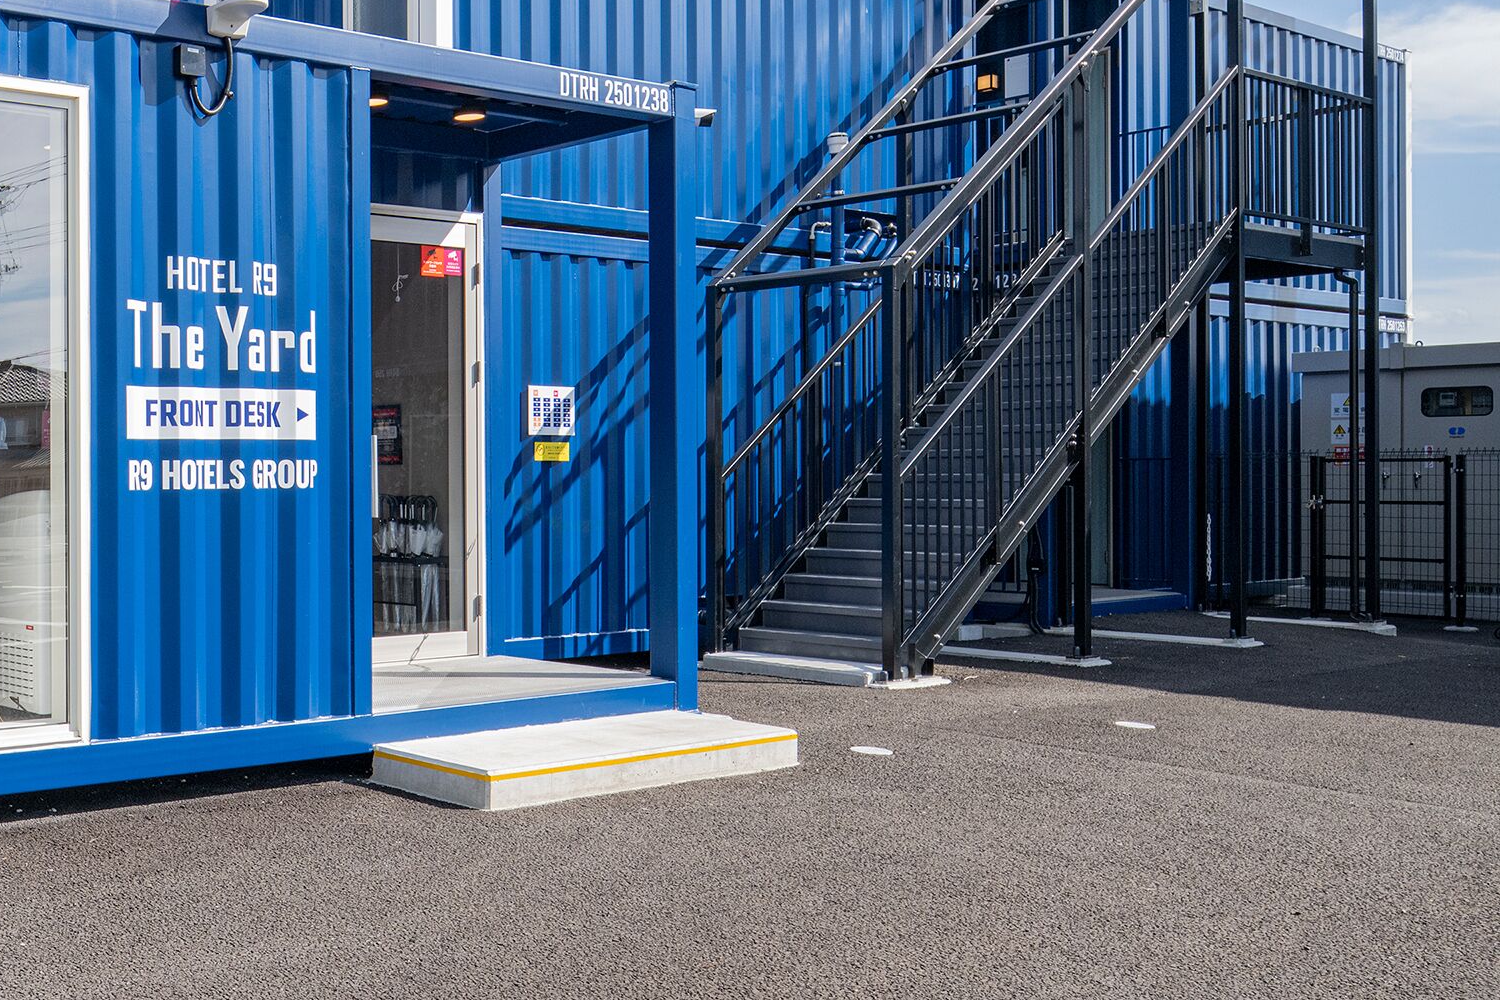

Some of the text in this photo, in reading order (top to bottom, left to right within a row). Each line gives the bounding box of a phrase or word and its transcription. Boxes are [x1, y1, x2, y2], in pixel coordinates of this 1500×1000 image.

[560, 72, 669, 113] DTRH 2501238
[166, 255, 277, 296] HOTEL R9
[127, 299, 316, 374] The Yard
[145, 399, 281, 428] FRONT DESK
[128, 459, 318, 491] R9 HOTELS GROUP
